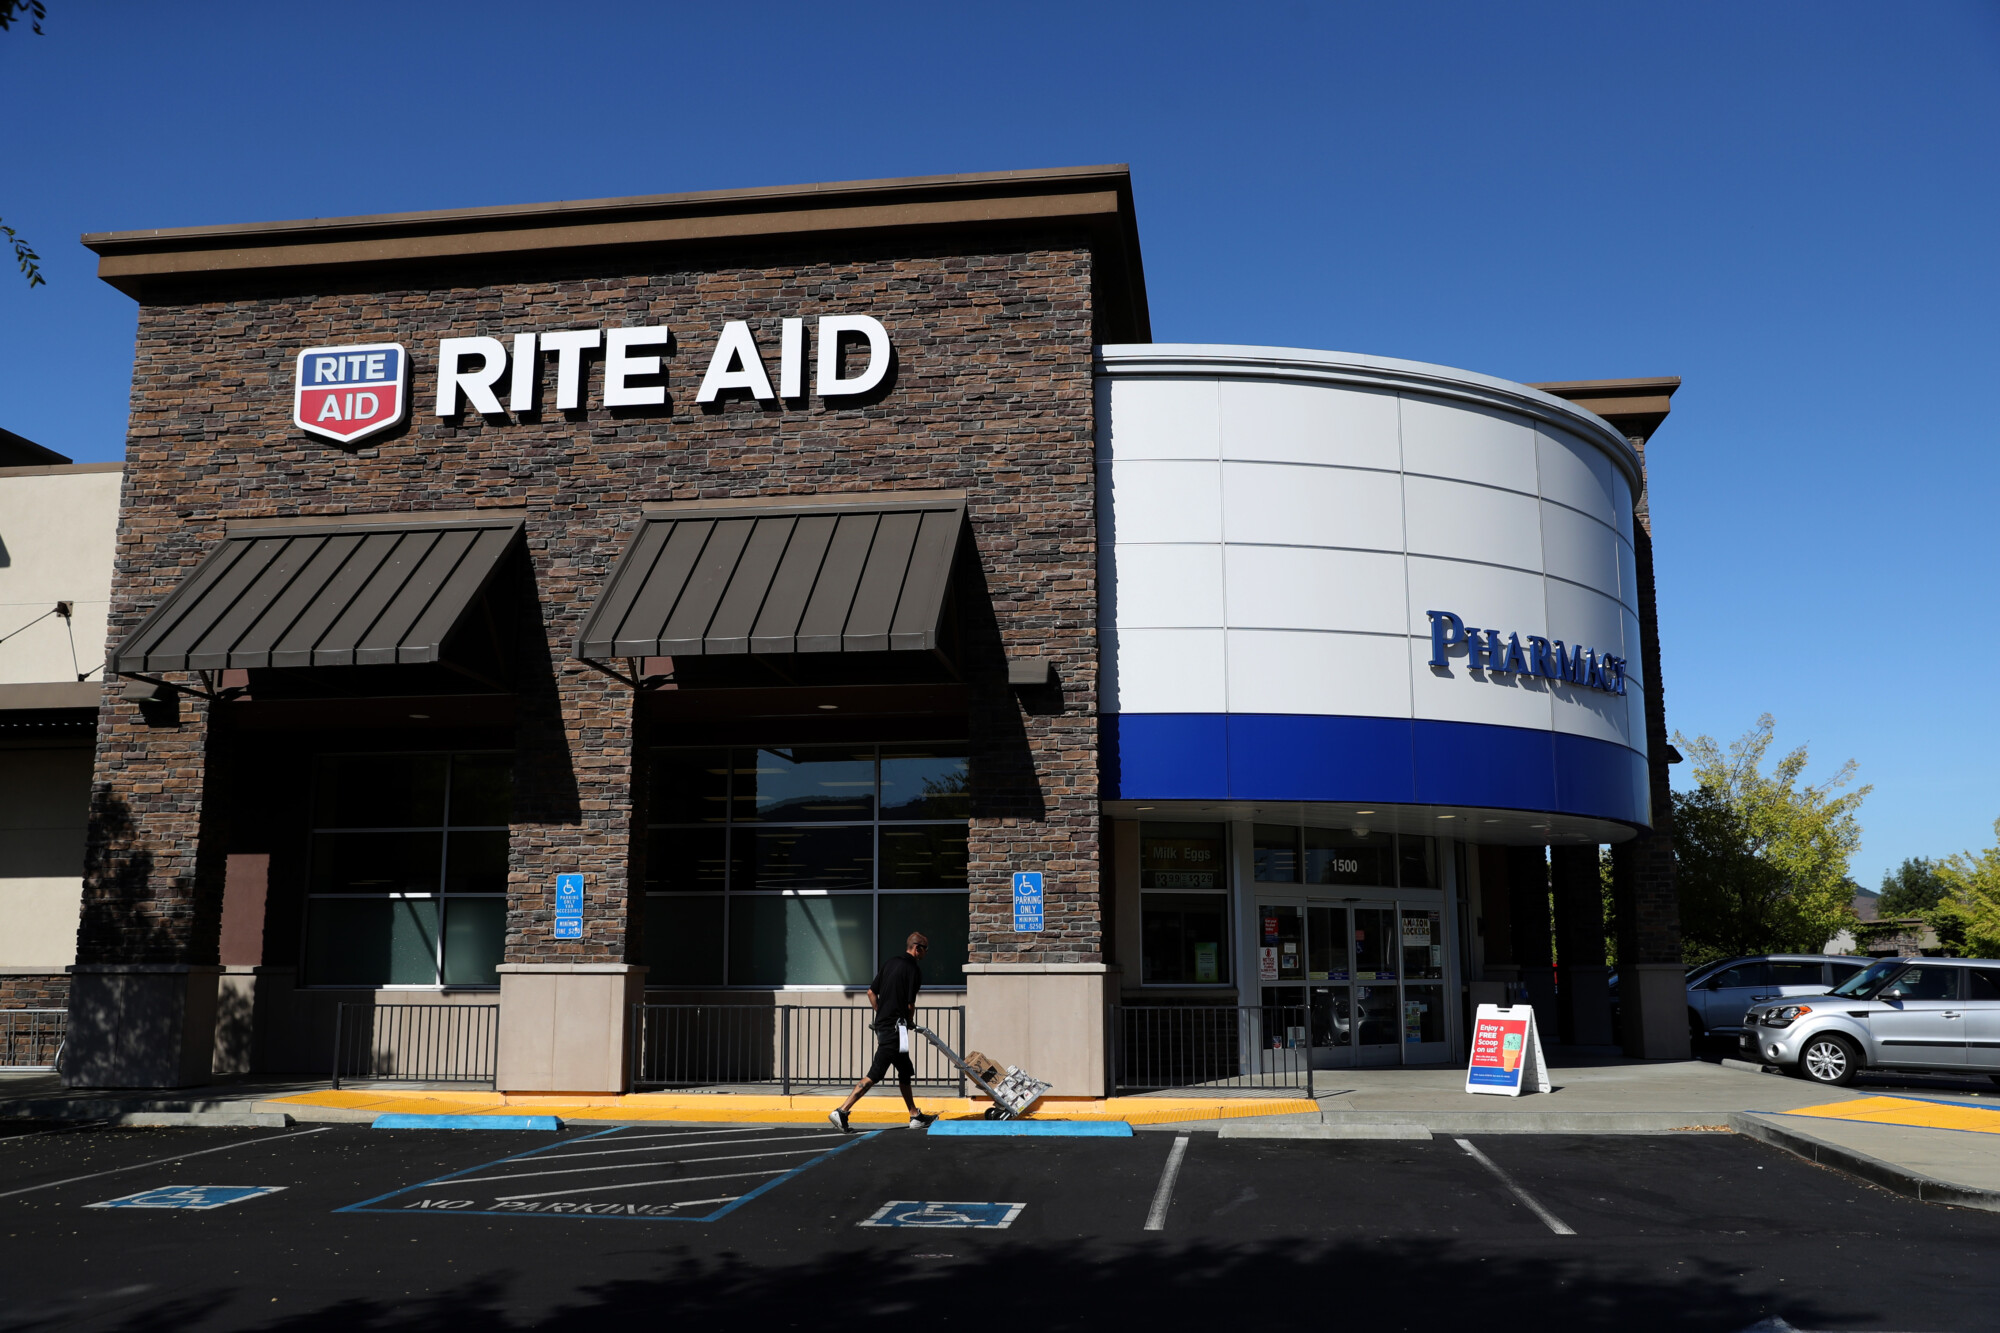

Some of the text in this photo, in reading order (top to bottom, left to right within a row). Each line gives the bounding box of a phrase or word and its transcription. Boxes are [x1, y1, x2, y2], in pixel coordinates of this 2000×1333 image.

[315, 353, 386, 382] RITE
[435, 314, 891, 416] RITE AID
[317, 392, 379, 422] AID
[1153, 847, 1211, 862] Milk Eggs
[1332, 859, 1357, 872] 1500
[1015, 896, 1042, 904] PARKING
[1020, 905, 1036, 914] ONLY
[1480, 1024, 1498, 1032] Enjoy
[403, 1200, 680, 1215] NO PARKING
